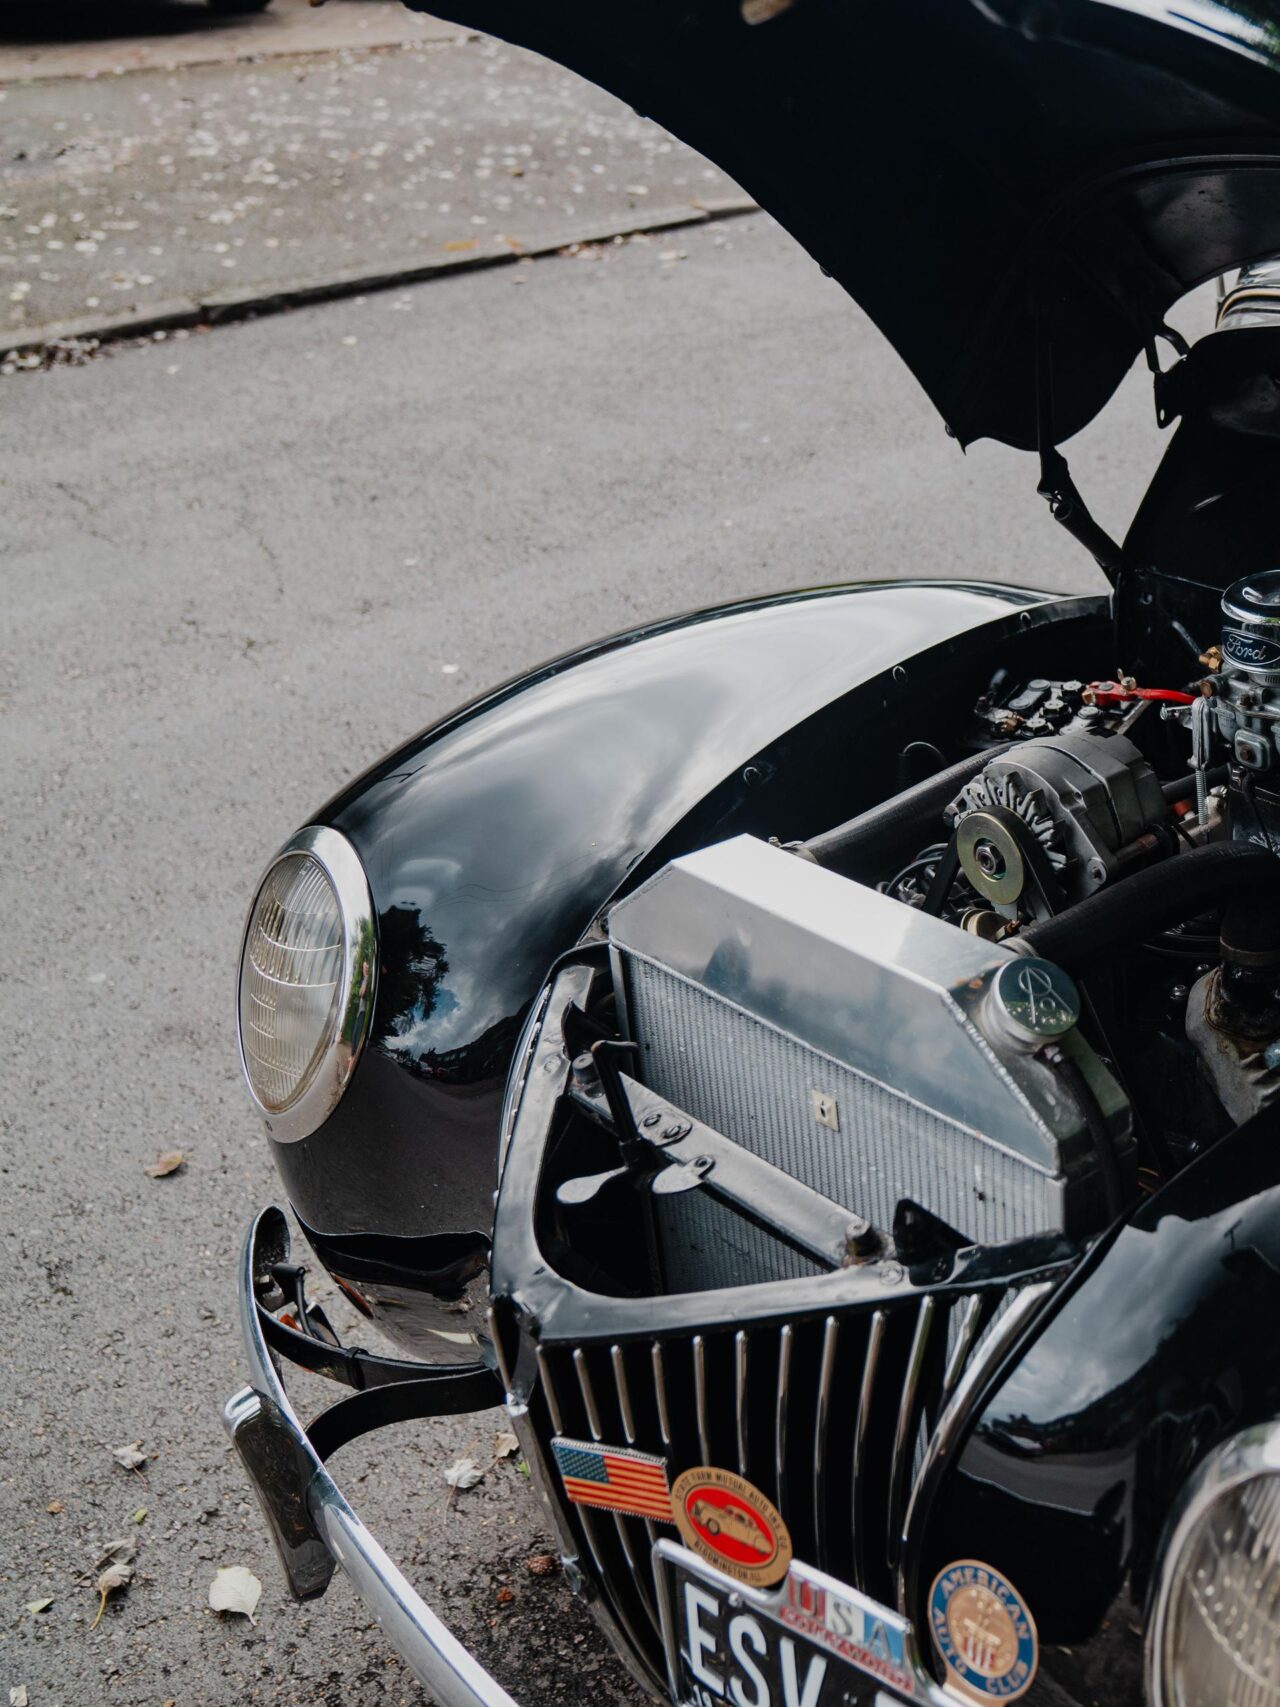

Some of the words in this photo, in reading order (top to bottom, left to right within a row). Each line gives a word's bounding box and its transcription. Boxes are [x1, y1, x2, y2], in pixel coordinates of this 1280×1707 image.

[1226, 633, 1267, 661] Ford
[941, 1567, 1030, 1639] AMERICAN
[685, 1582, 827, 1707] ESV
[933, 1606, 967, 1675] AUTO
[985, 1659, 1028, 1695] CLUB
